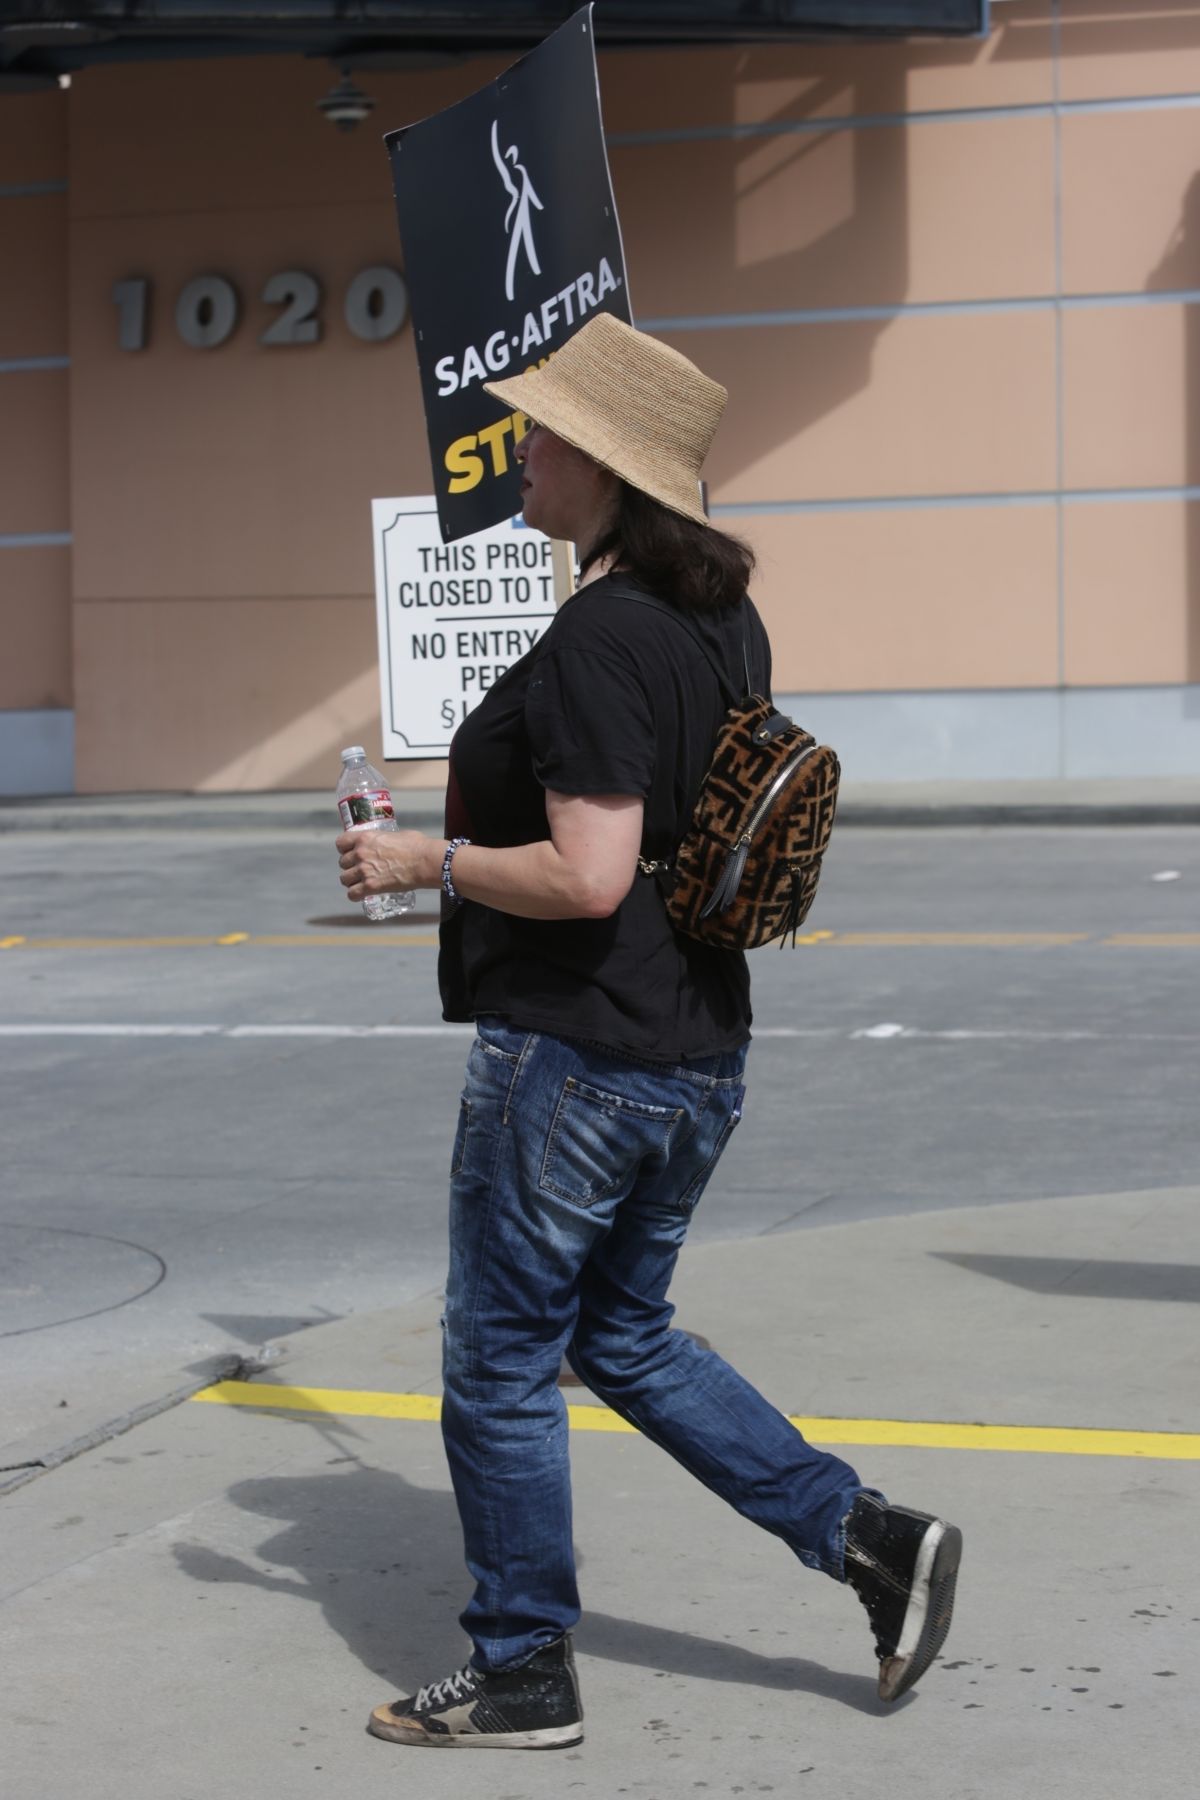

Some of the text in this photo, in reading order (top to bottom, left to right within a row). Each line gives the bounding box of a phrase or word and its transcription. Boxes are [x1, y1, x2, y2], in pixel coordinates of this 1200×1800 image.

[112, 266, 408, 351] 1020
[418, 544, 476, 573] THIS
[399, 578, 492, 608] CLOSED
[499, 576, 531, 604] TO
[411, 629, 539, 660] NO ENTRY
